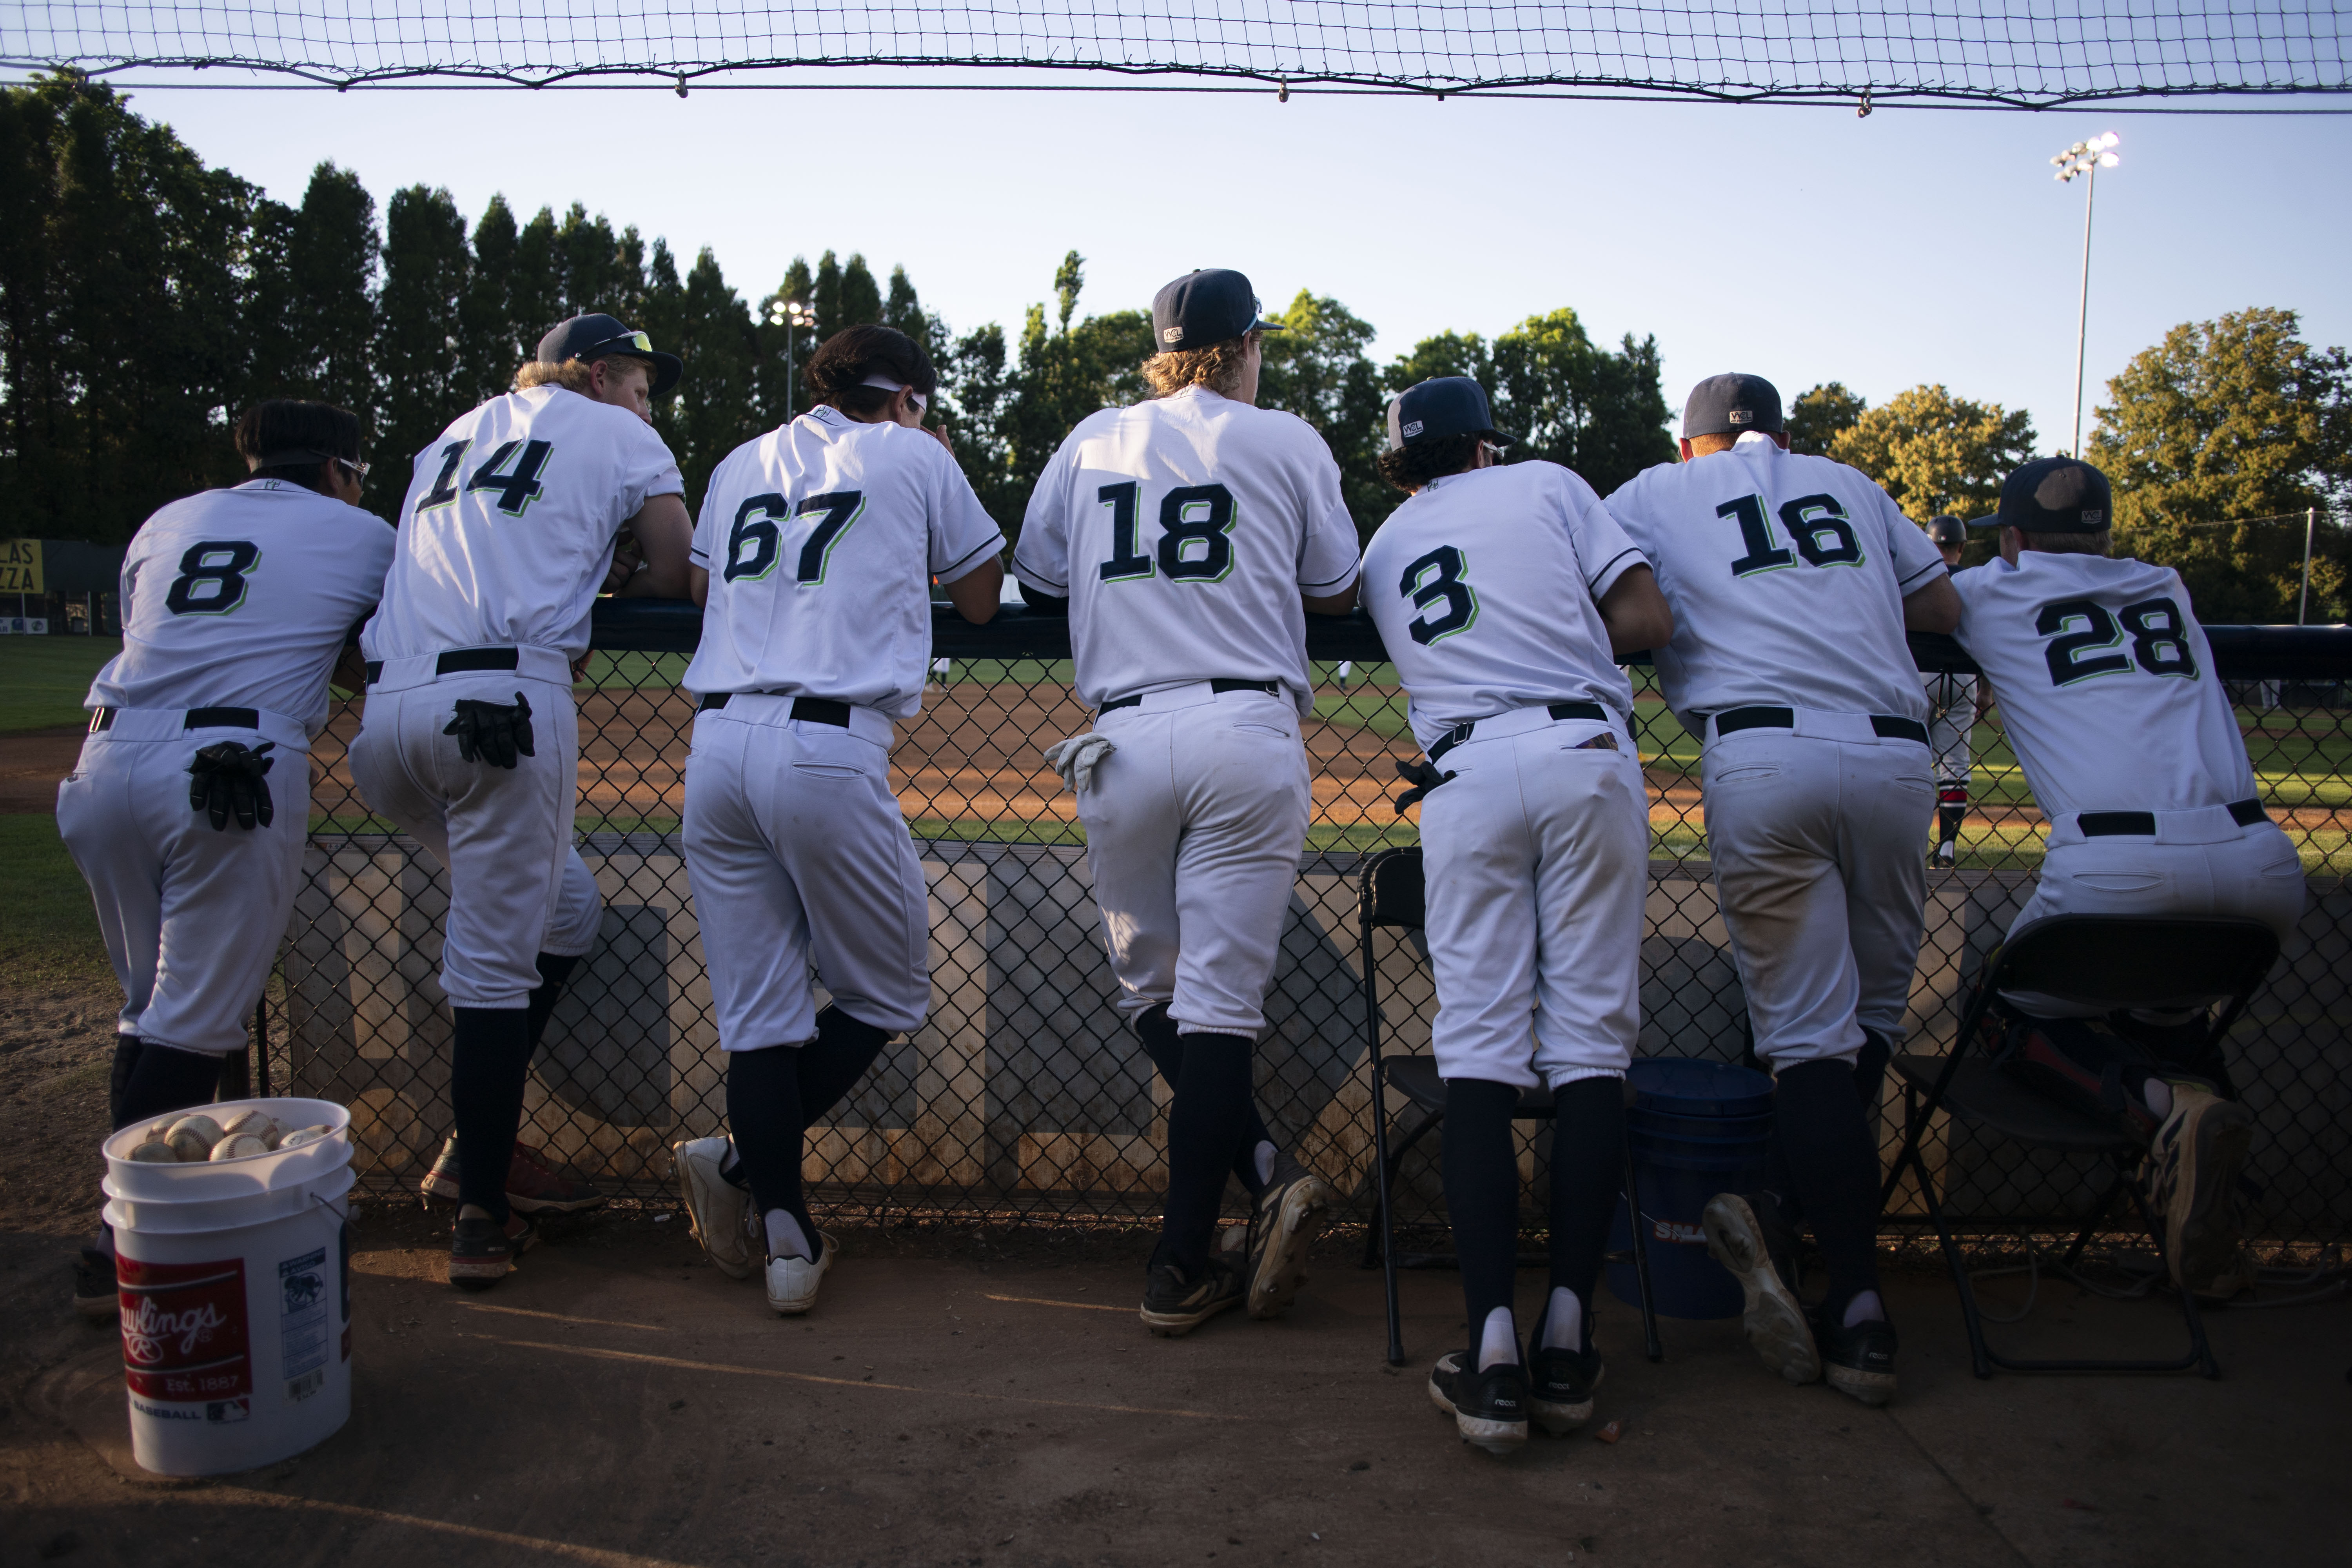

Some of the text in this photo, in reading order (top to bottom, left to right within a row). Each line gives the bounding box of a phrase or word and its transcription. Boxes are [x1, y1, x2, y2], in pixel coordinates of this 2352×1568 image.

[1165, 328, 1182, 338] WCL
[1404, 422, 1422, 434] WCL
[1731, 411, 1751, 419] WCL
[416, 437, 555, 518] 14
[723, 490, 866, 587] 67
[1098, 481, 1238, 584] 18
[1715, 493, 1866, 579] 16
[165, 540, 262, 617] 8
[1399, 545, 1480, 646] 3
[2035, 597, 2200, 687] 28
[133, 1400, 201, 1420] BASEBALL
[166, 1374, 239, 1392] Est. 1887
